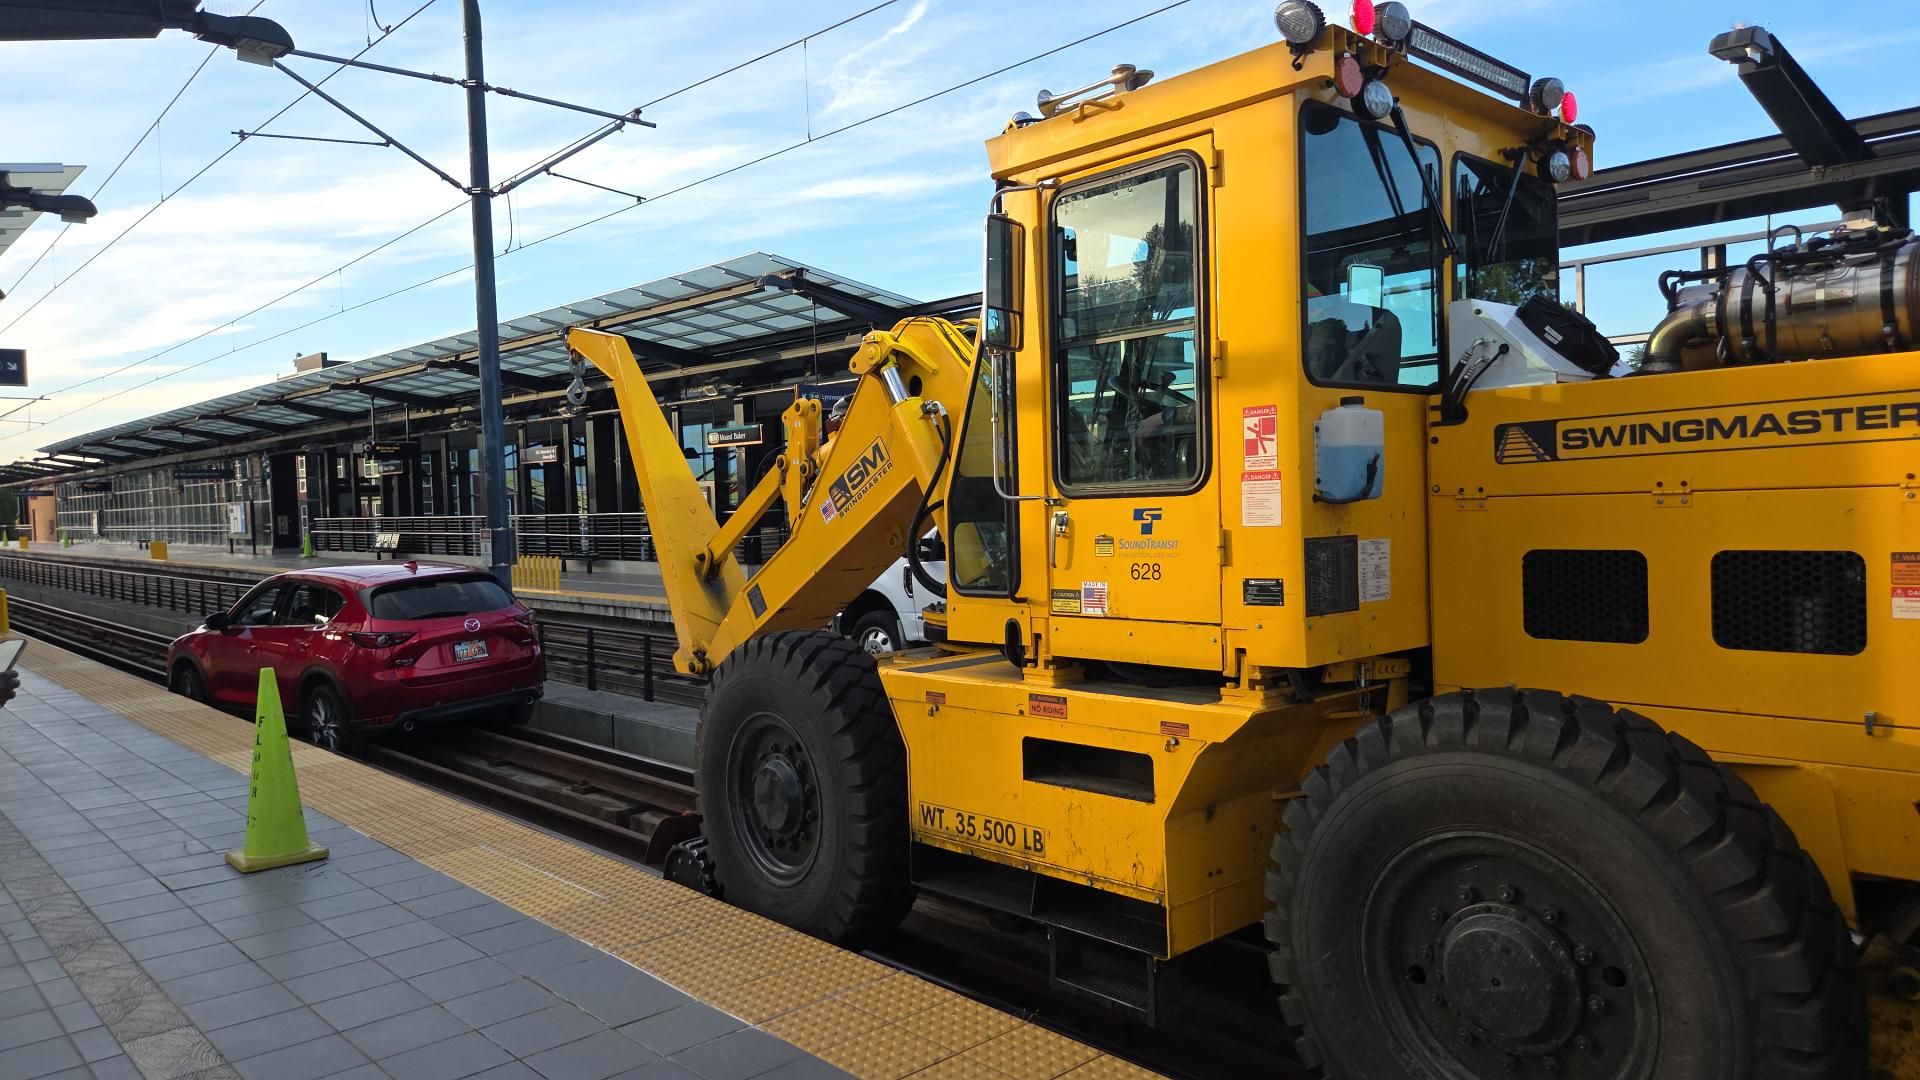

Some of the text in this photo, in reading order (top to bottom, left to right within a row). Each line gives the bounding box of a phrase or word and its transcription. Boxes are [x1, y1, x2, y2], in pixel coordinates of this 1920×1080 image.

[720, 433, 733, 441] Mount
[733, 431, 746, 440] Baker
[1561, 402, 1920, 450] SWINGMASTER
[839, 462, 893, 518] SWINGMASTER
[1131, 563, 1161, 580] 628
[1031, 703, 1042, 712] NO
[921, 804, 1044, 853] WT. 35,500 LB
